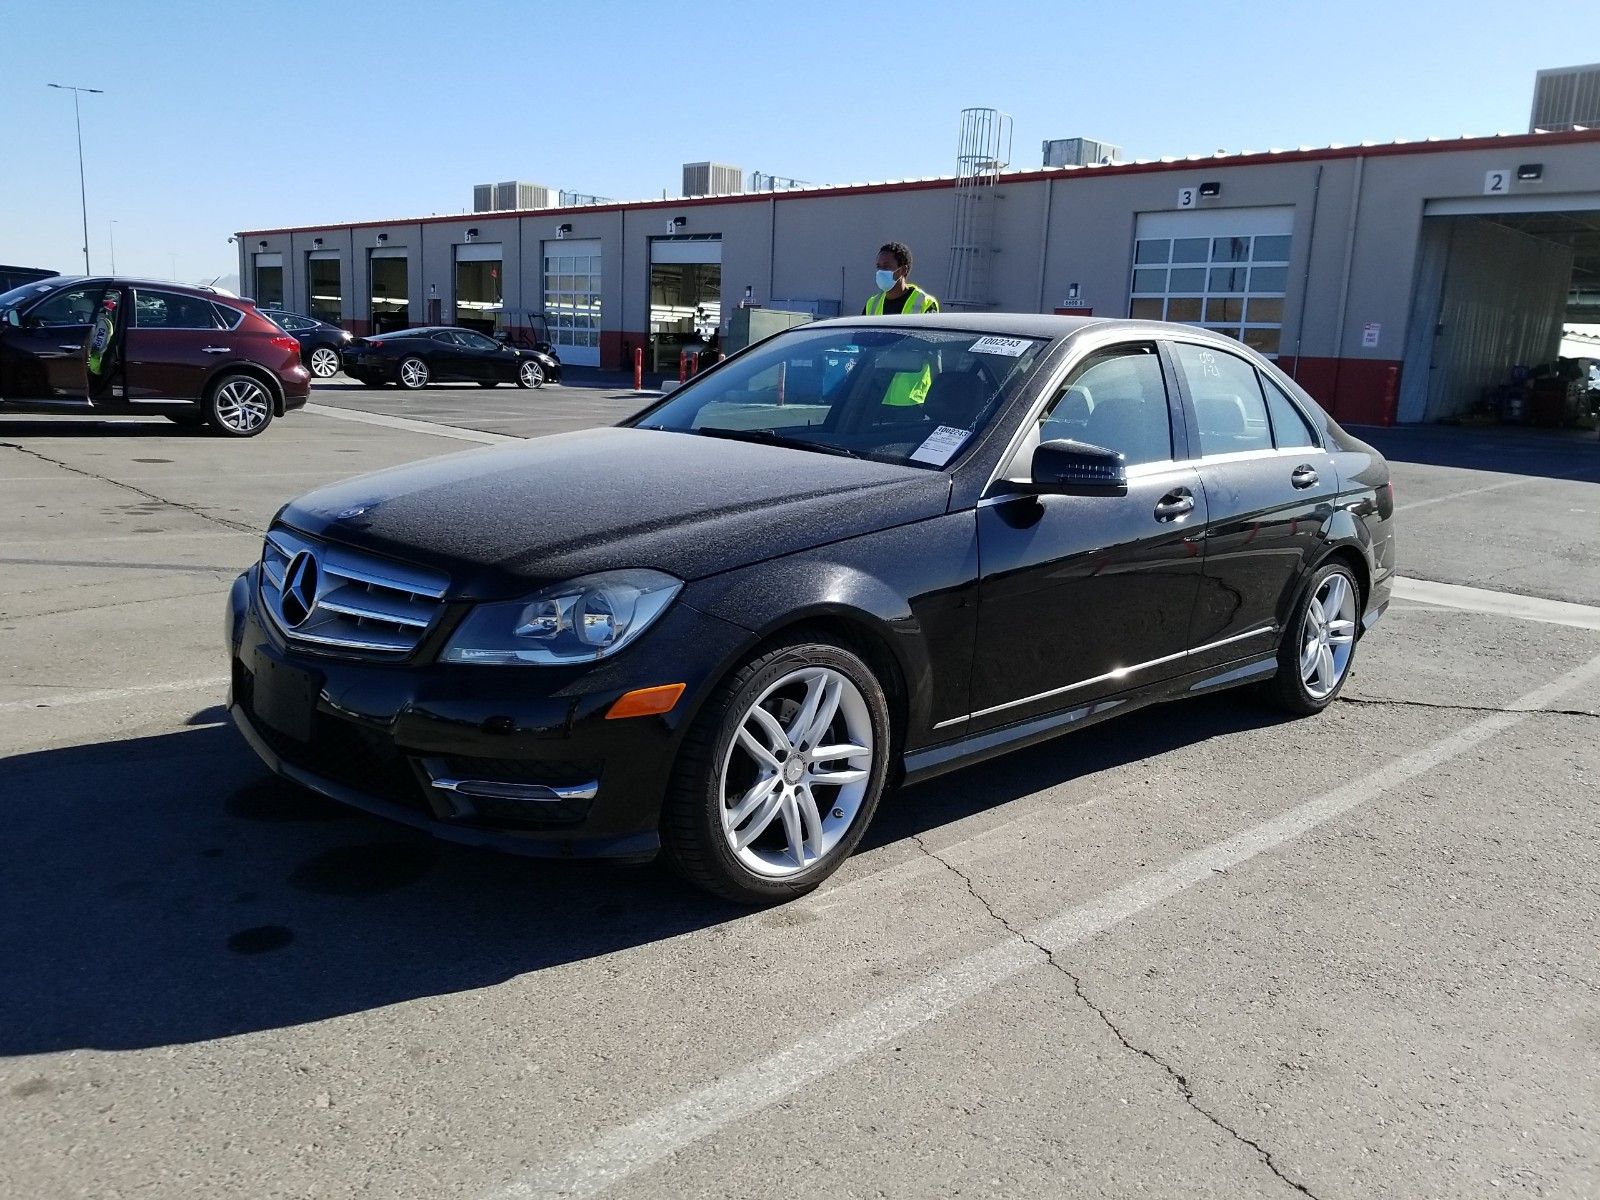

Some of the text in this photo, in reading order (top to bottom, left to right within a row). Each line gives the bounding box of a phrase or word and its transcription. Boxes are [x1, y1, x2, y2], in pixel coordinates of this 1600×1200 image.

[1491, 174, 1503, 191] 2
[1182, 190, 1192, 206] 3
[980, 337, 1022, 348] 1002243
